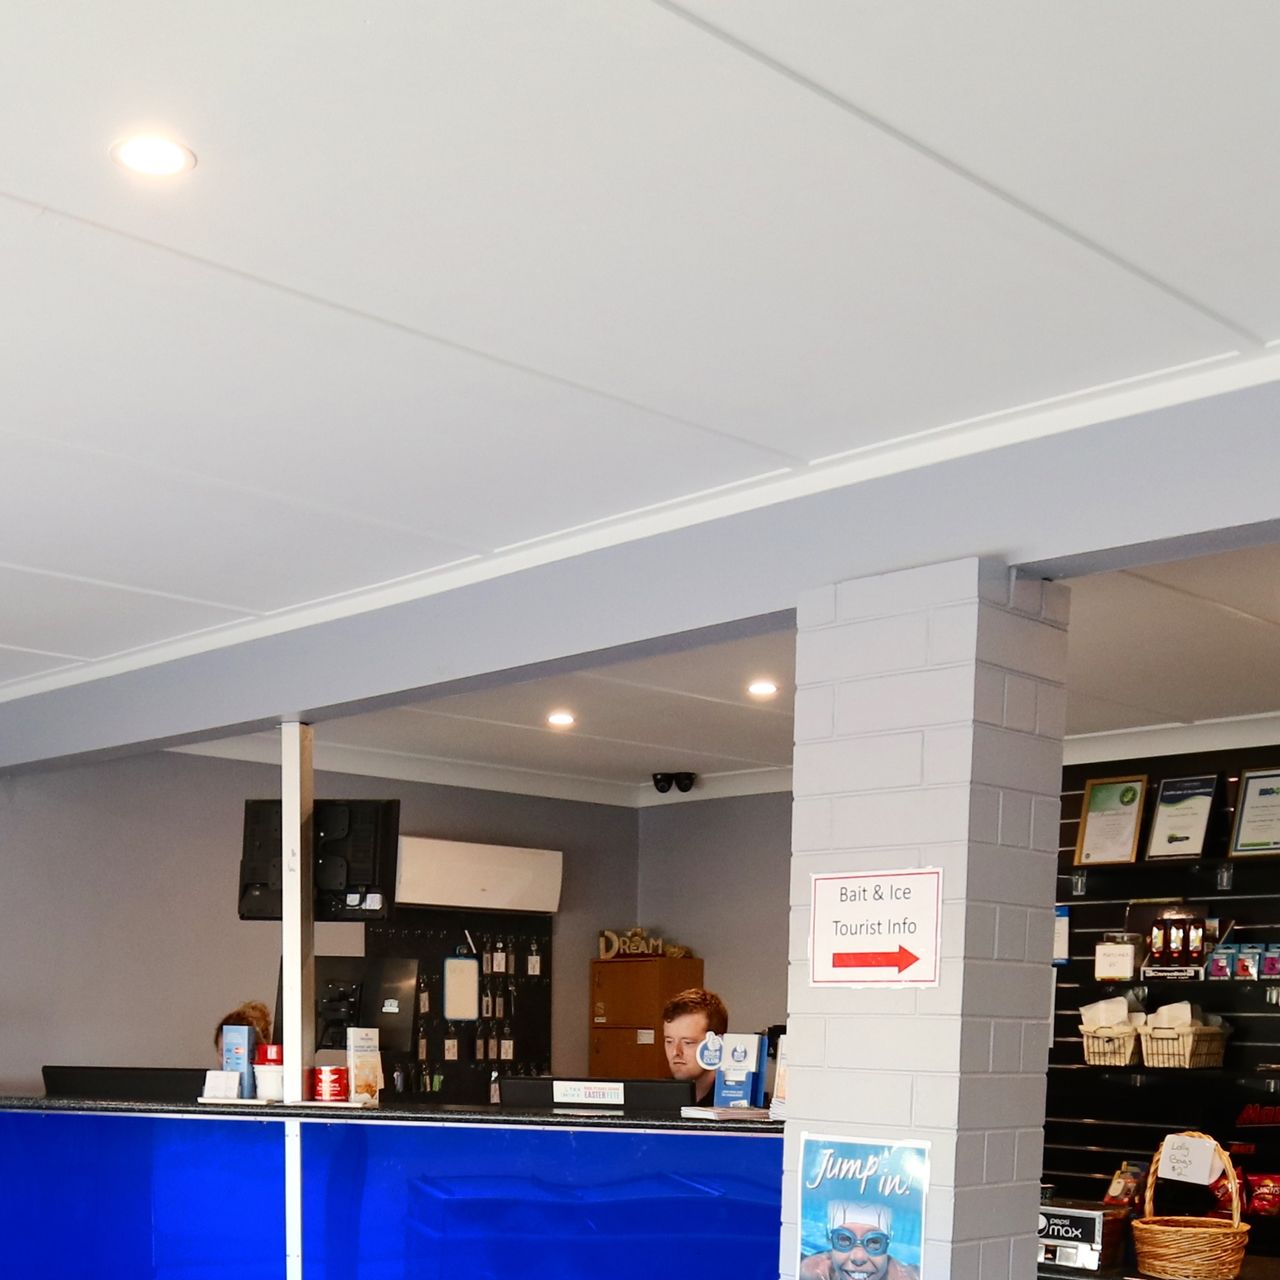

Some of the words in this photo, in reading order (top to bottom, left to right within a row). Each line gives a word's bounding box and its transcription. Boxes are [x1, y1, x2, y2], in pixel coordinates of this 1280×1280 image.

[840, 886, 867, 902] Bait
[873, 885, 884, 901] &
[890, 884, 911, 900] Ice
[833, 919, 883, 936] Tourist
[888, 917, 917, 935] Info
[599, 930, 663, 959] DREAM
[806, 1149, 880, 1195] Jump
[1050, 1218, 1070, 1226] pepsi
[1049, 1224, 1082, 1239] max
